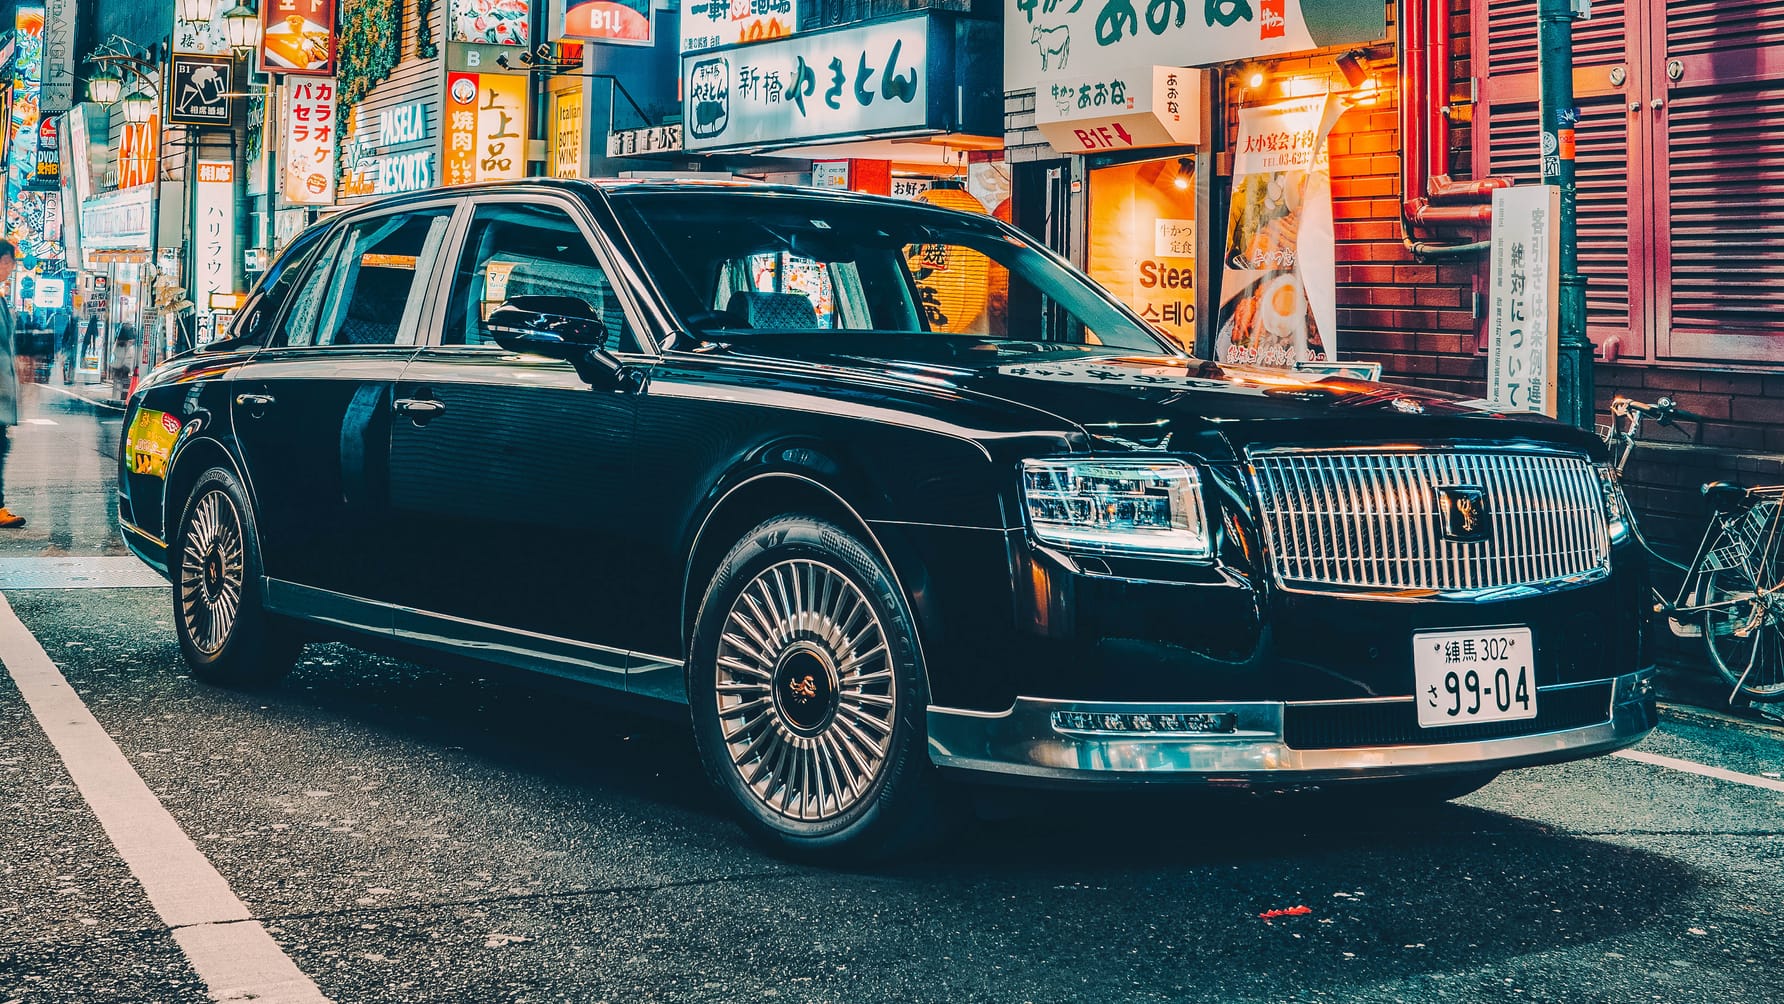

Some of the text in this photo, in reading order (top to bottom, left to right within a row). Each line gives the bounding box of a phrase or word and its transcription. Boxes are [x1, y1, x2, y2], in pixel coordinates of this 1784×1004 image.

[591, 9, 611, 29] B1
[179, 65, 190, 73] B1
[1052, 83, 1074, 100] 牛かつ
[1077, 78, 1126, 109] あおな
[1166, 73, 1179, 114] あおな
[293, 83, 312, 142] パセラ
[315, 84, 331, 164] カラオケ
[381, 103, 424, 145] PASELA
[560, 105, 581, 120] Italian
[480, 88, 519, 172] 上上品
[559, 130, 579, 148] BOTTLE
[1074, 127, 1113, 149] B1F
[558, 148, 577, 164] WINE
[380, 151, 431, 194] RESORTS
[1161, 223, 1192, 238] 牛かつ
[1170, 241, 1192, 254] 定食
[1507, 242, 1526, 407] 絶対について
[1445, 637, 1508, 663] 練馬 302
[1427, 666, 1529, 717] さ 99-04
